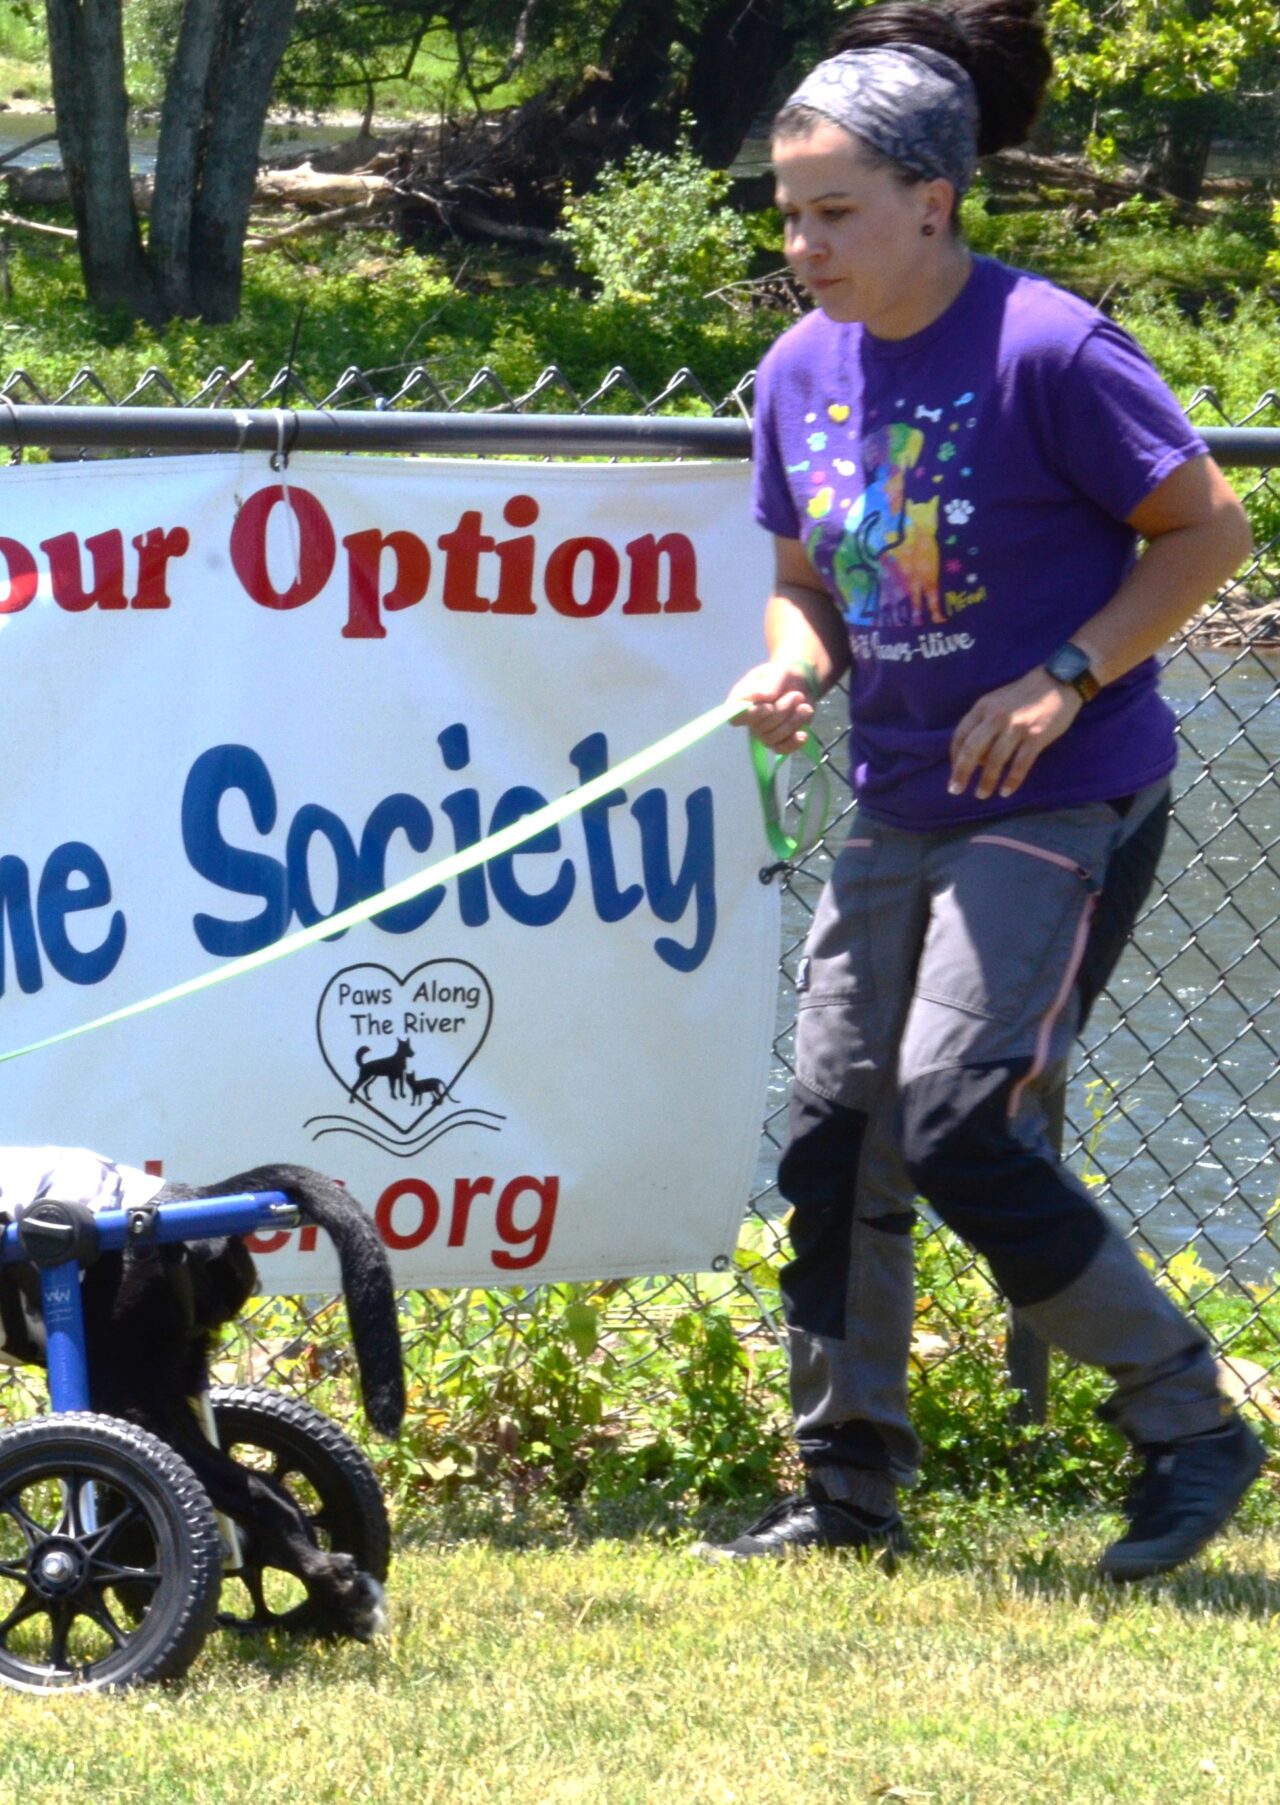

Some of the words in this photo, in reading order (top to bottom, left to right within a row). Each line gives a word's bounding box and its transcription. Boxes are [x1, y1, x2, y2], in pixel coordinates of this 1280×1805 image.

[229, 484, 702, 638] Option
[181, 722, 717, 972] Society
[338, 983, 393, 1006] Paws
[412, 980, 481, 1009] Along
[349, 1012, 394, 1036] The
[403, 1011, 467, 1034] River
